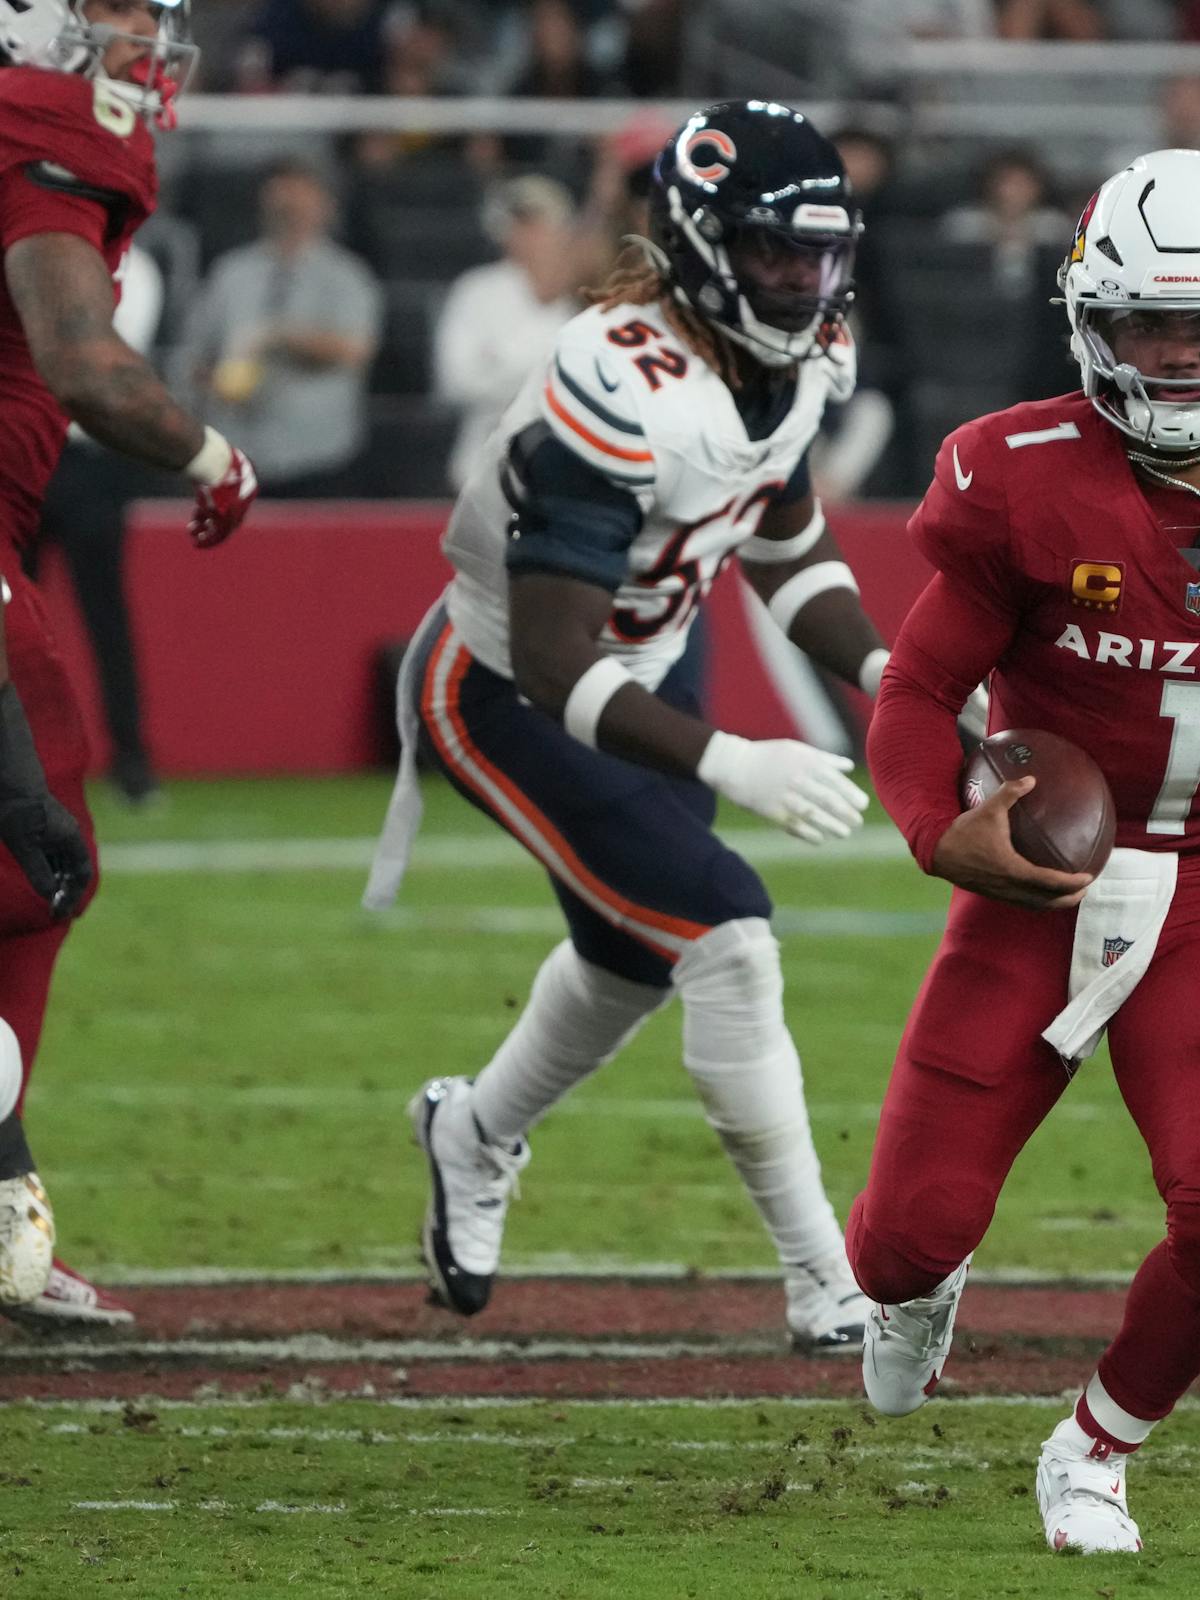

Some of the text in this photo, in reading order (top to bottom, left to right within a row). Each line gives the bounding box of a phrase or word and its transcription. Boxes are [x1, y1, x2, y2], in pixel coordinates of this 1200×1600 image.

[607, 319, 689, 393] 52
[1005, 421, 1081, 450] 1
[1071, 562, 1122, 602] C
